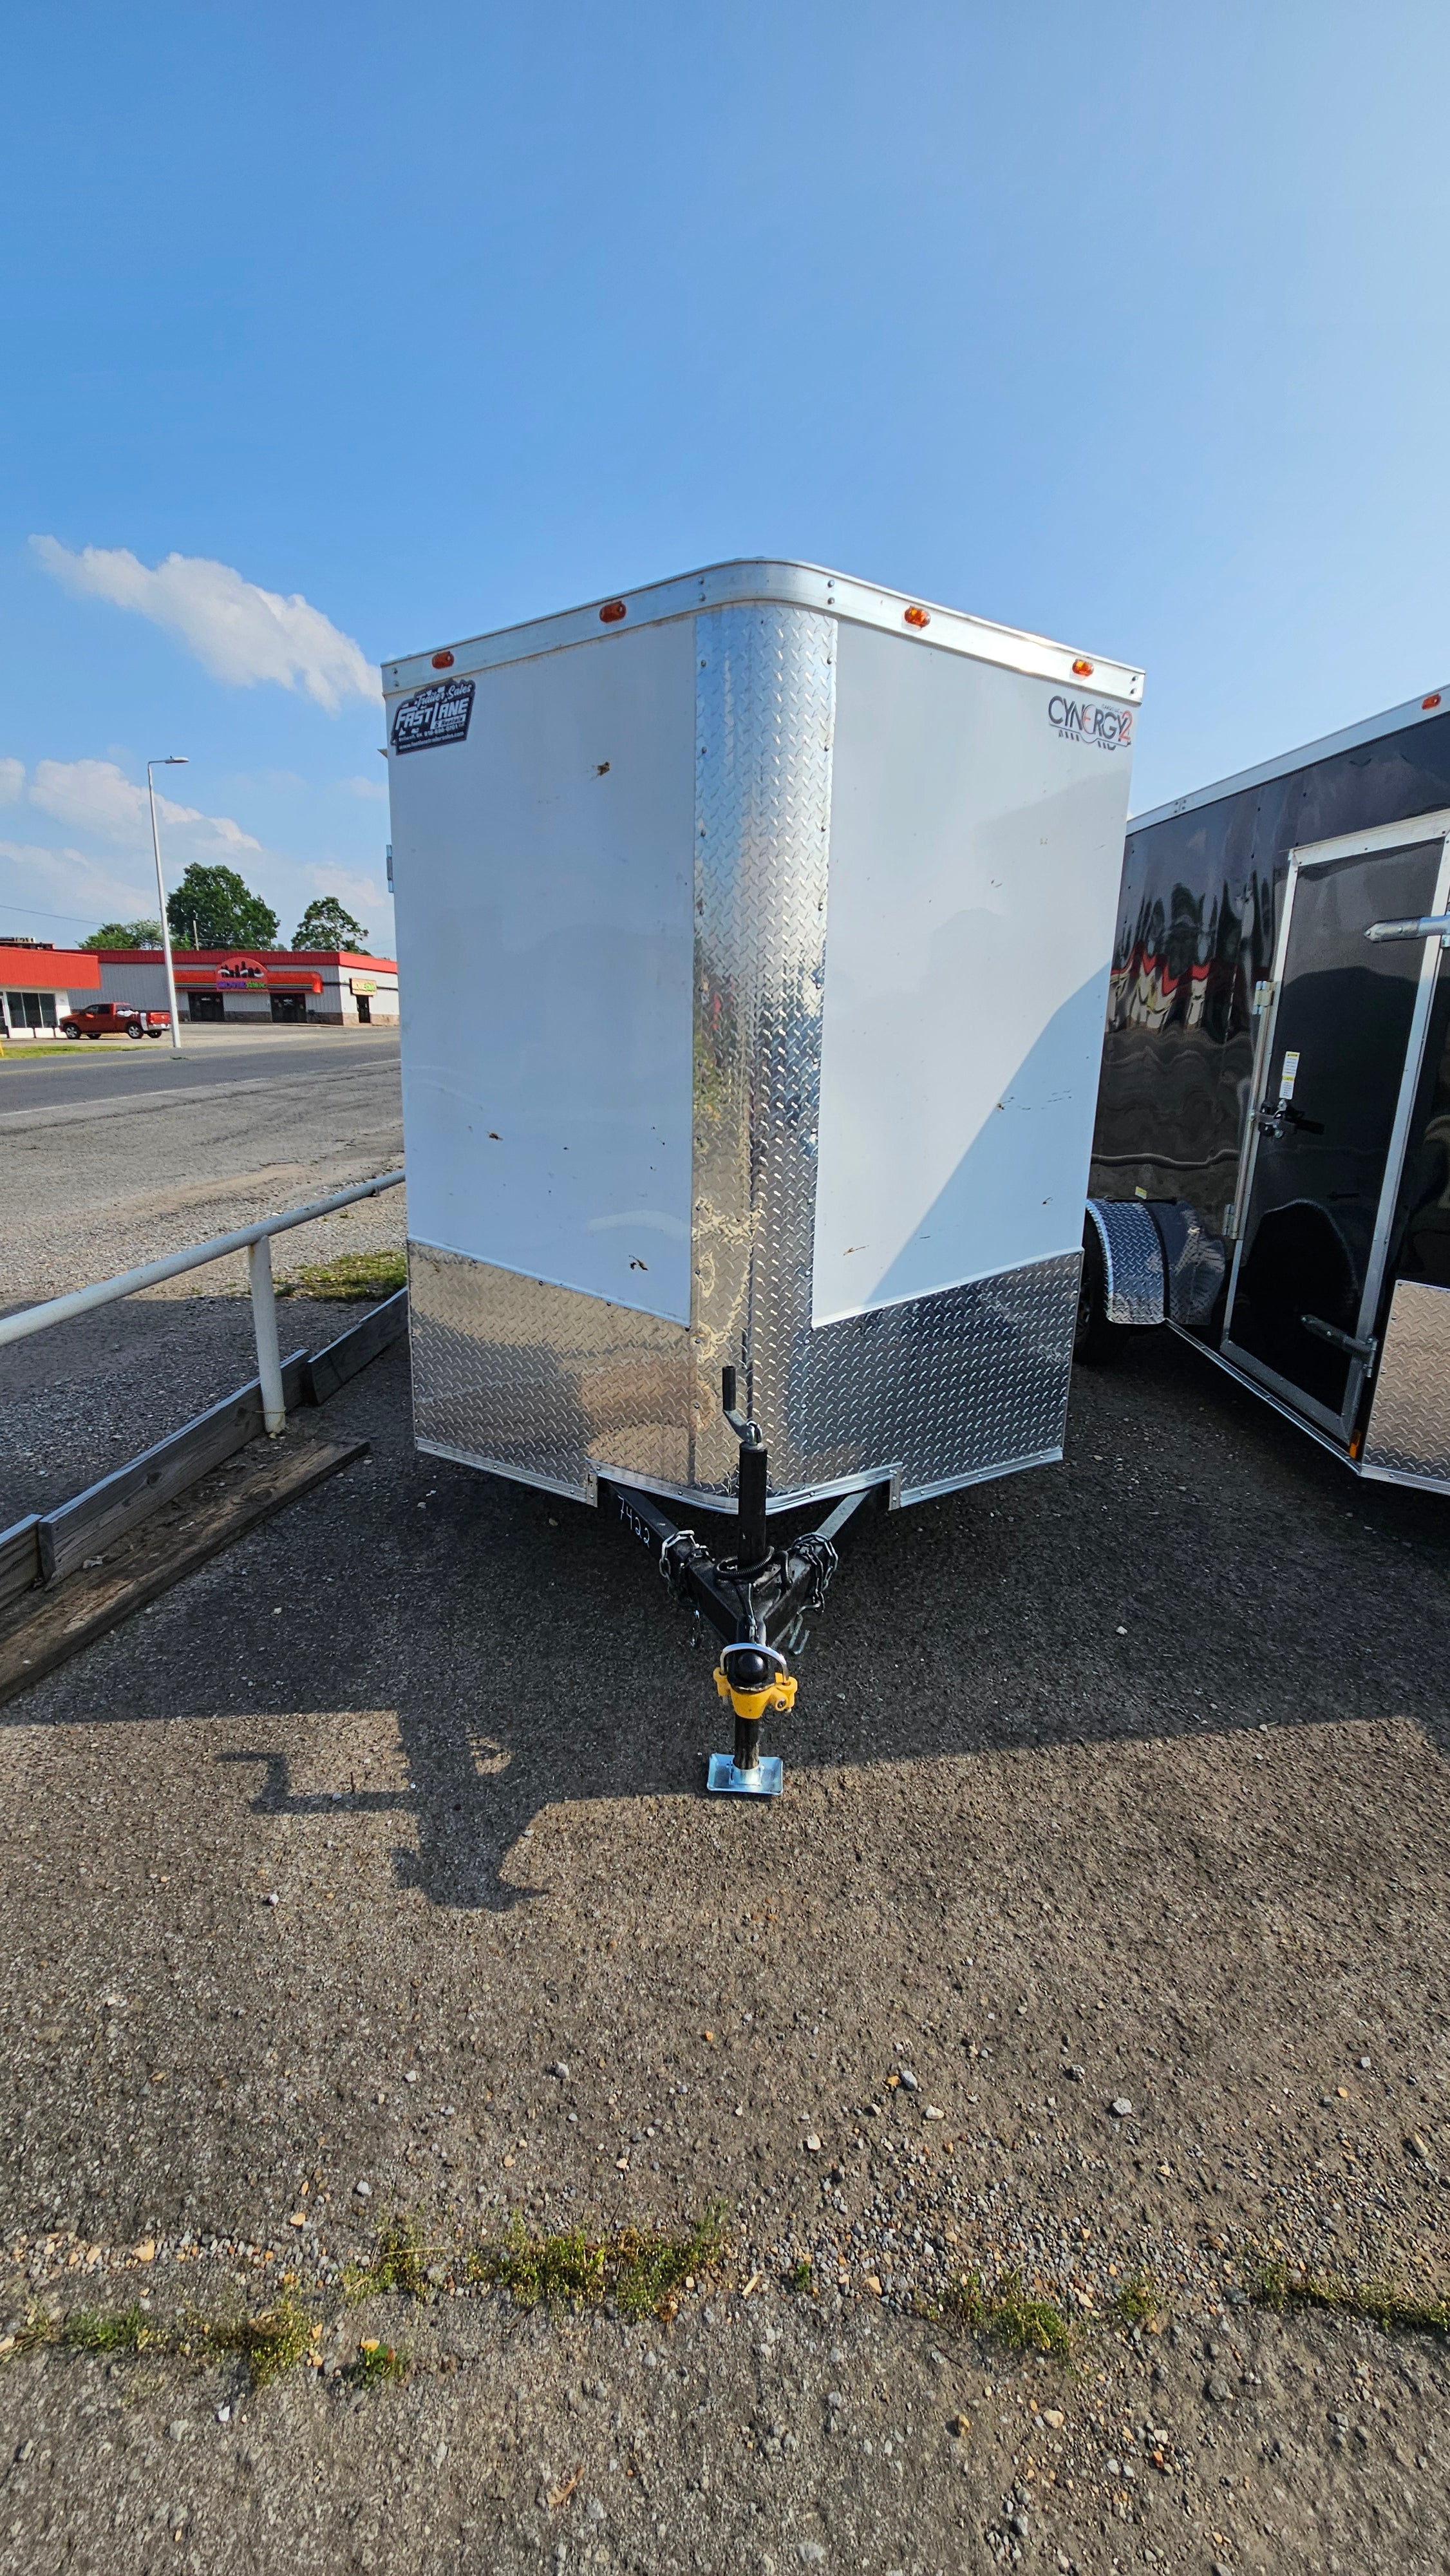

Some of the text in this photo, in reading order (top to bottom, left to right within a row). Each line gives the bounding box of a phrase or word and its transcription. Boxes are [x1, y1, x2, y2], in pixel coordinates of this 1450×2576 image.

[416, 684, 473, 708] Trailer Sales
[617, 1494, 650, 1549] 7422
